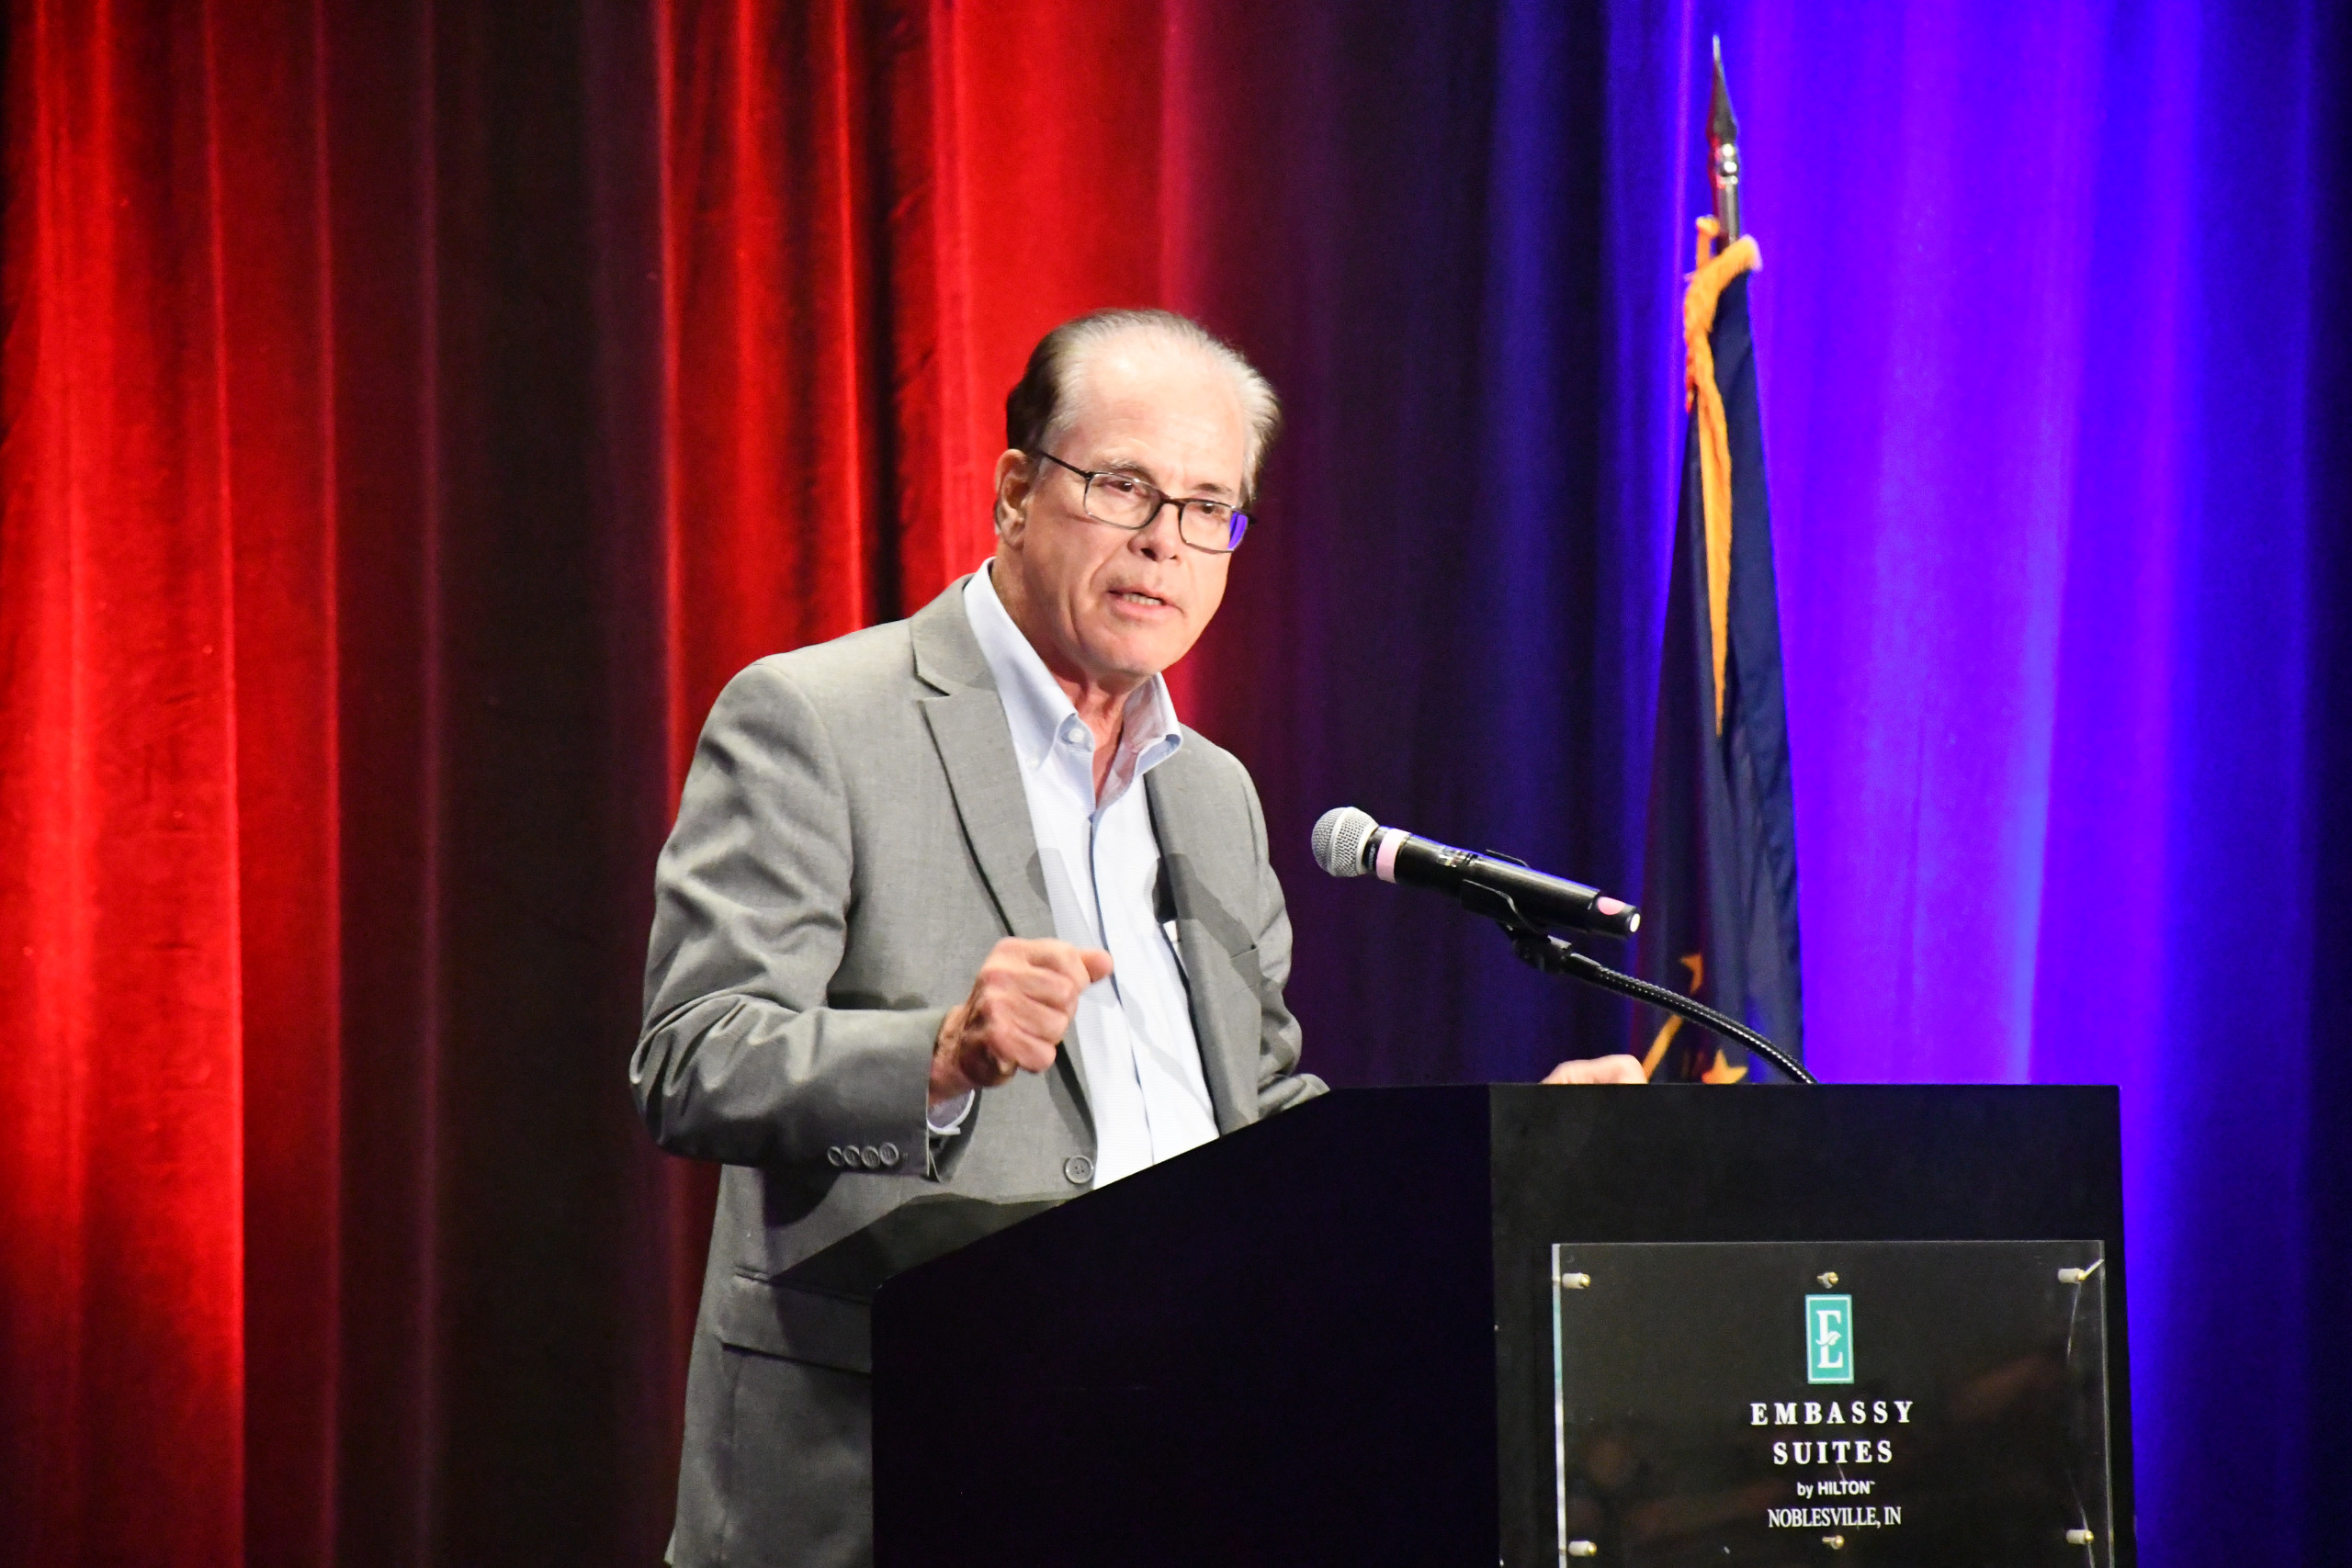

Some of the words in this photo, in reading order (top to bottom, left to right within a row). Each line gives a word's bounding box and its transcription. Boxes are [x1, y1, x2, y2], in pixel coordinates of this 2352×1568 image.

[1749, 1400, 1914, 1426] EMBASSY
[1772, 1439, 1893, 1465] SUITES
[1796, 1482, 1814, 1499] by
[1767, 1506, 1882, 1529] NOBLESVILLE,
[1883, 1506, 1902, 1526] IN
